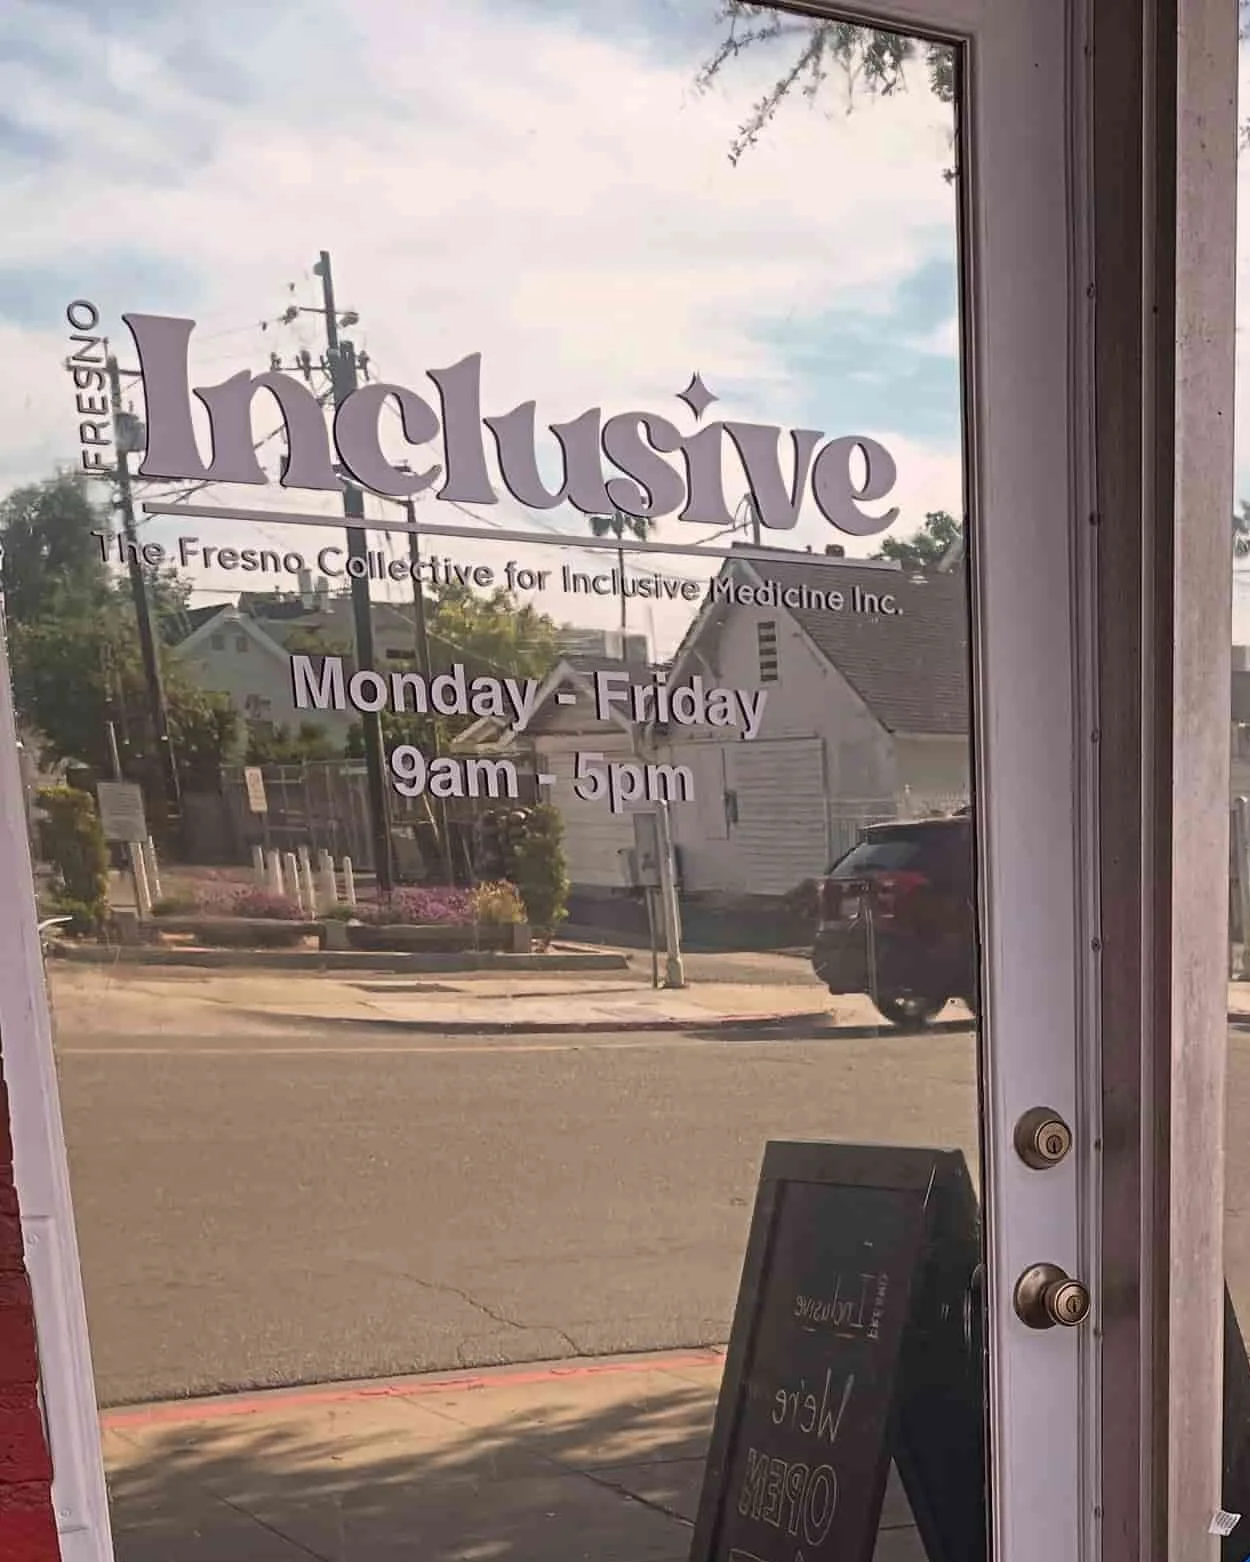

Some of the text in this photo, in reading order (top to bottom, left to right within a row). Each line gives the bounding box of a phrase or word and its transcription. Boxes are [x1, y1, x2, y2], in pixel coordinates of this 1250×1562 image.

[65, 298, 112, 476] FRESNO
[122, 311, 902, 537] Inclusive
[91, 530, 905, 618] The Fresno Collective for Inclusive Medicine Inc.
[289, 654, 540, 732] Monday
[594, 669, 769, 741] Friday
[389, 744, 520, 800] 9am
[573, 751, 695, 813] 5pm
